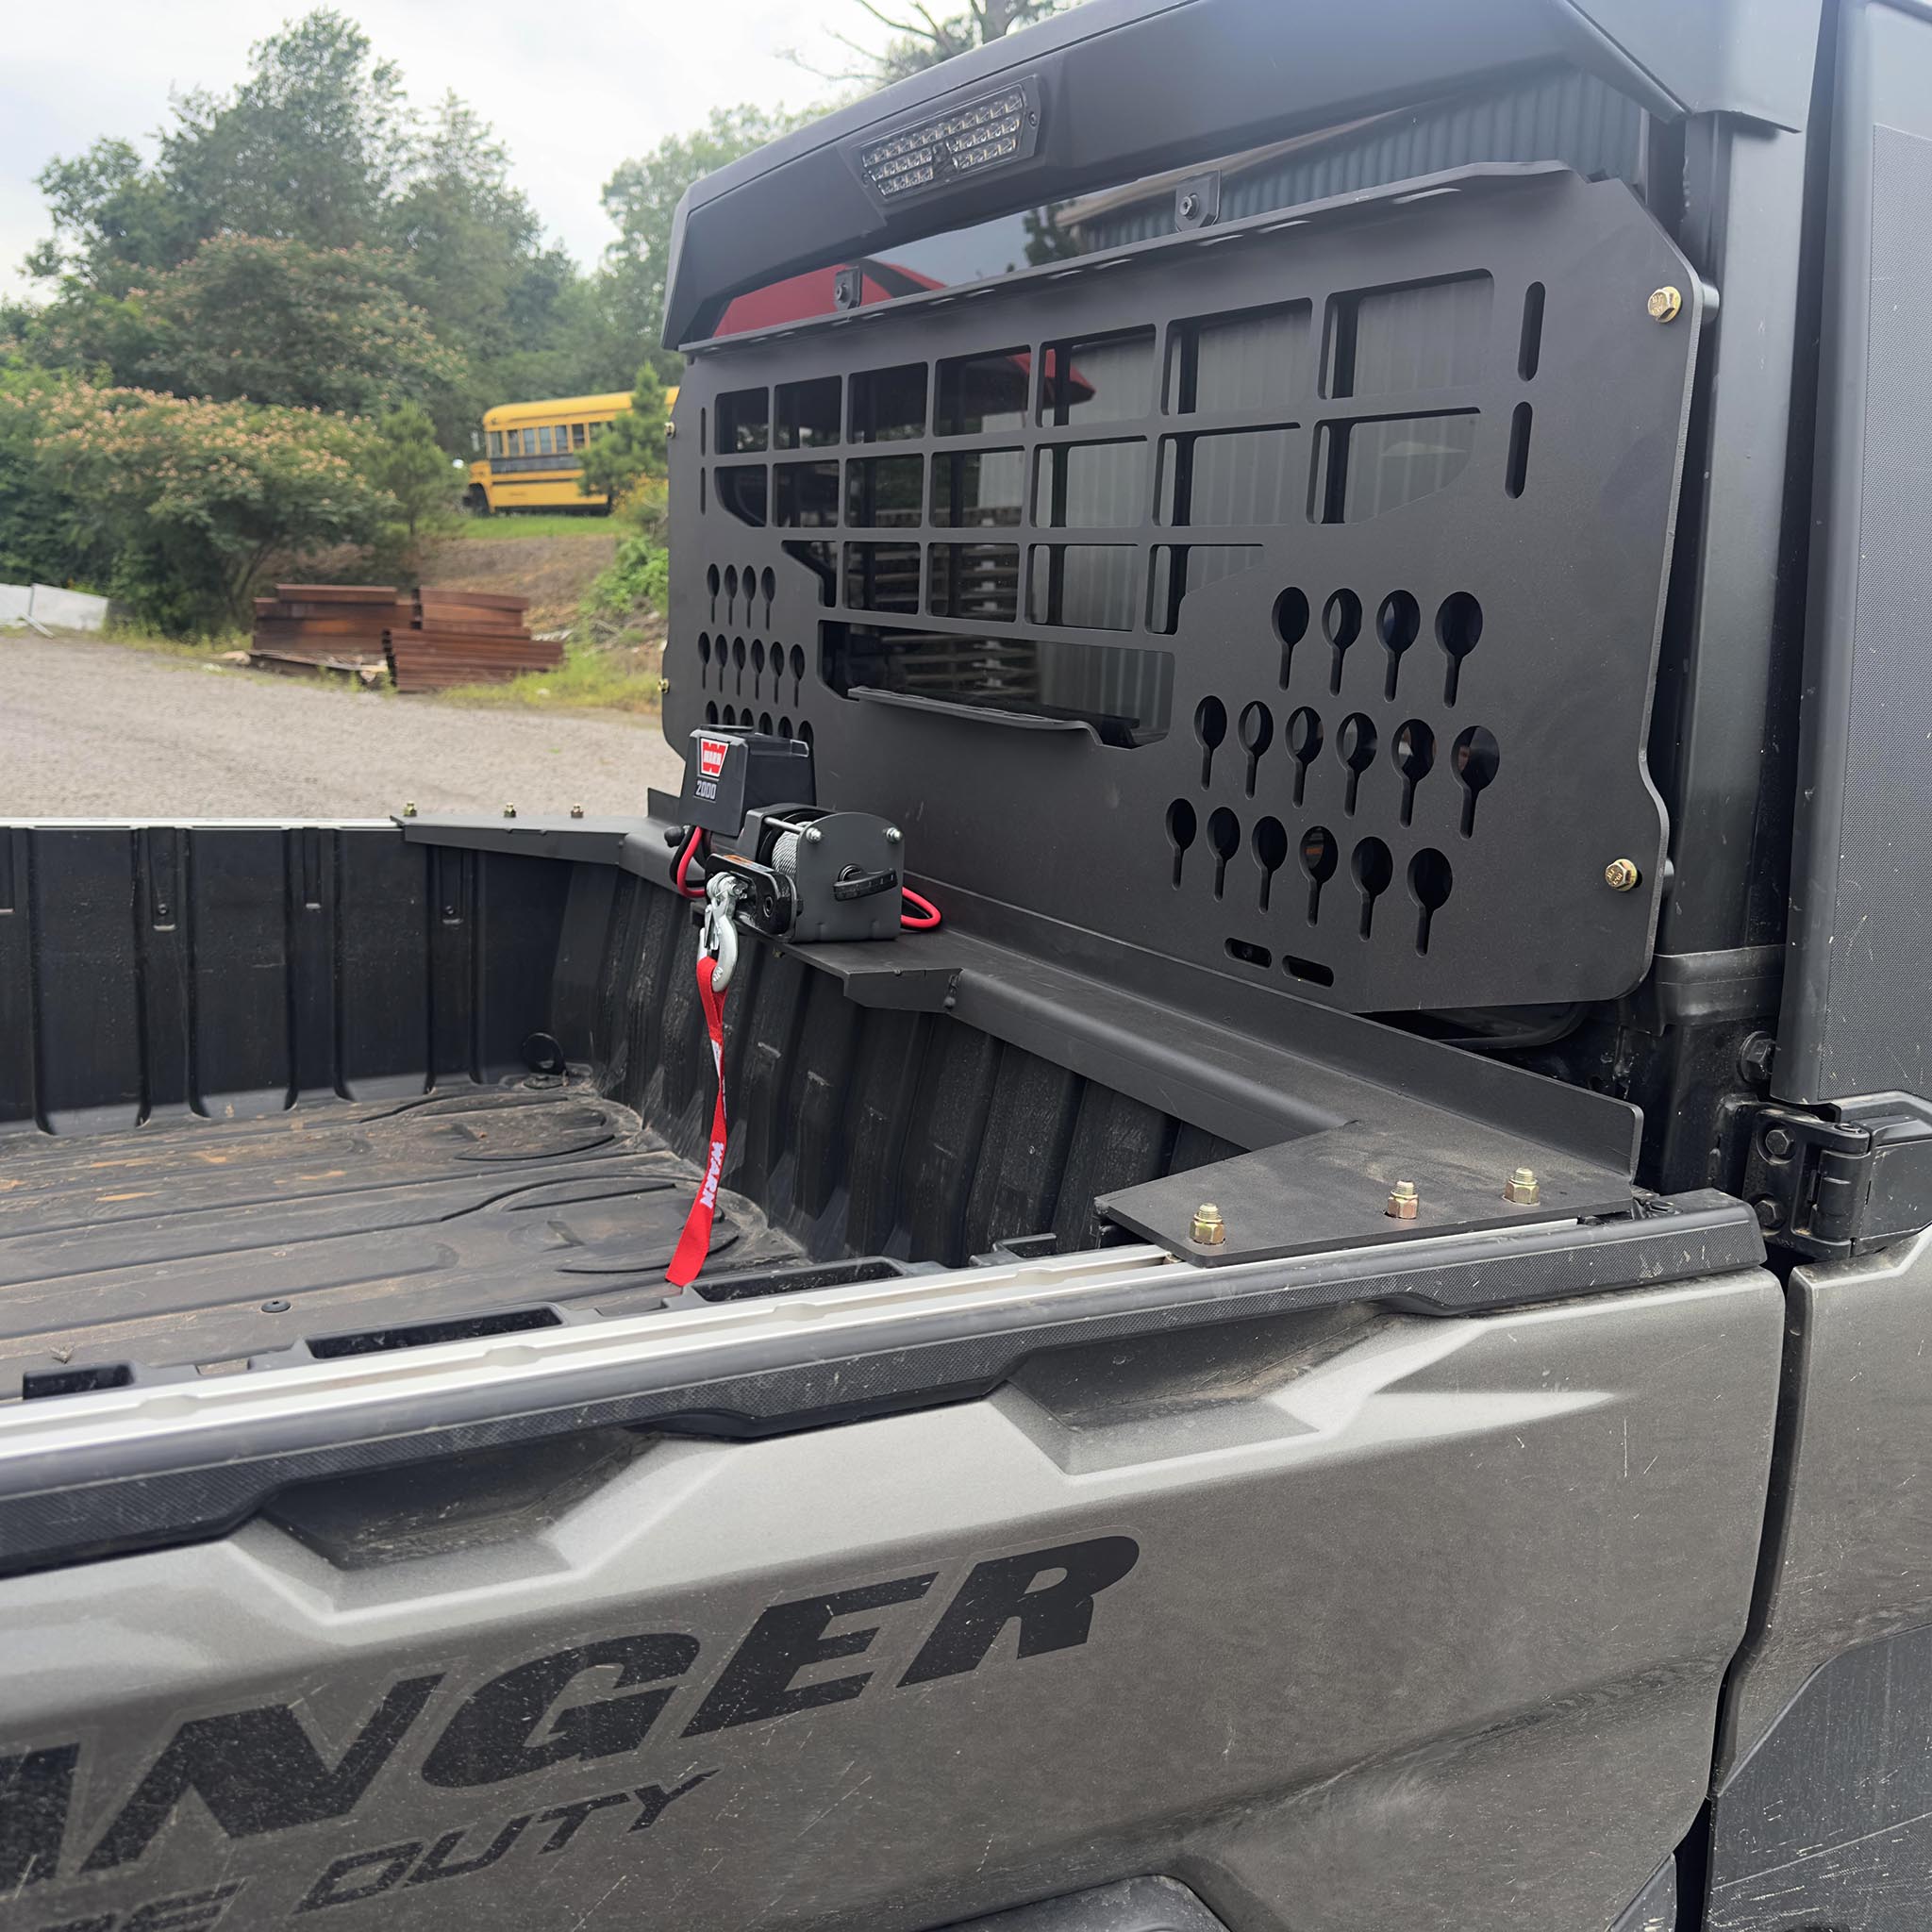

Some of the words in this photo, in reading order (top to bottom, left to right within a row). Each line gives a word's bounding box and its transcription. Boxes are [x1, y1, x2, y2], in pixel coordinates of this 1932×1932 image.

[695, 780, 717, 800] 2000
[699, 1141, 724, 1208] WARN
[292, 1769, 721, 1914] DUTY
